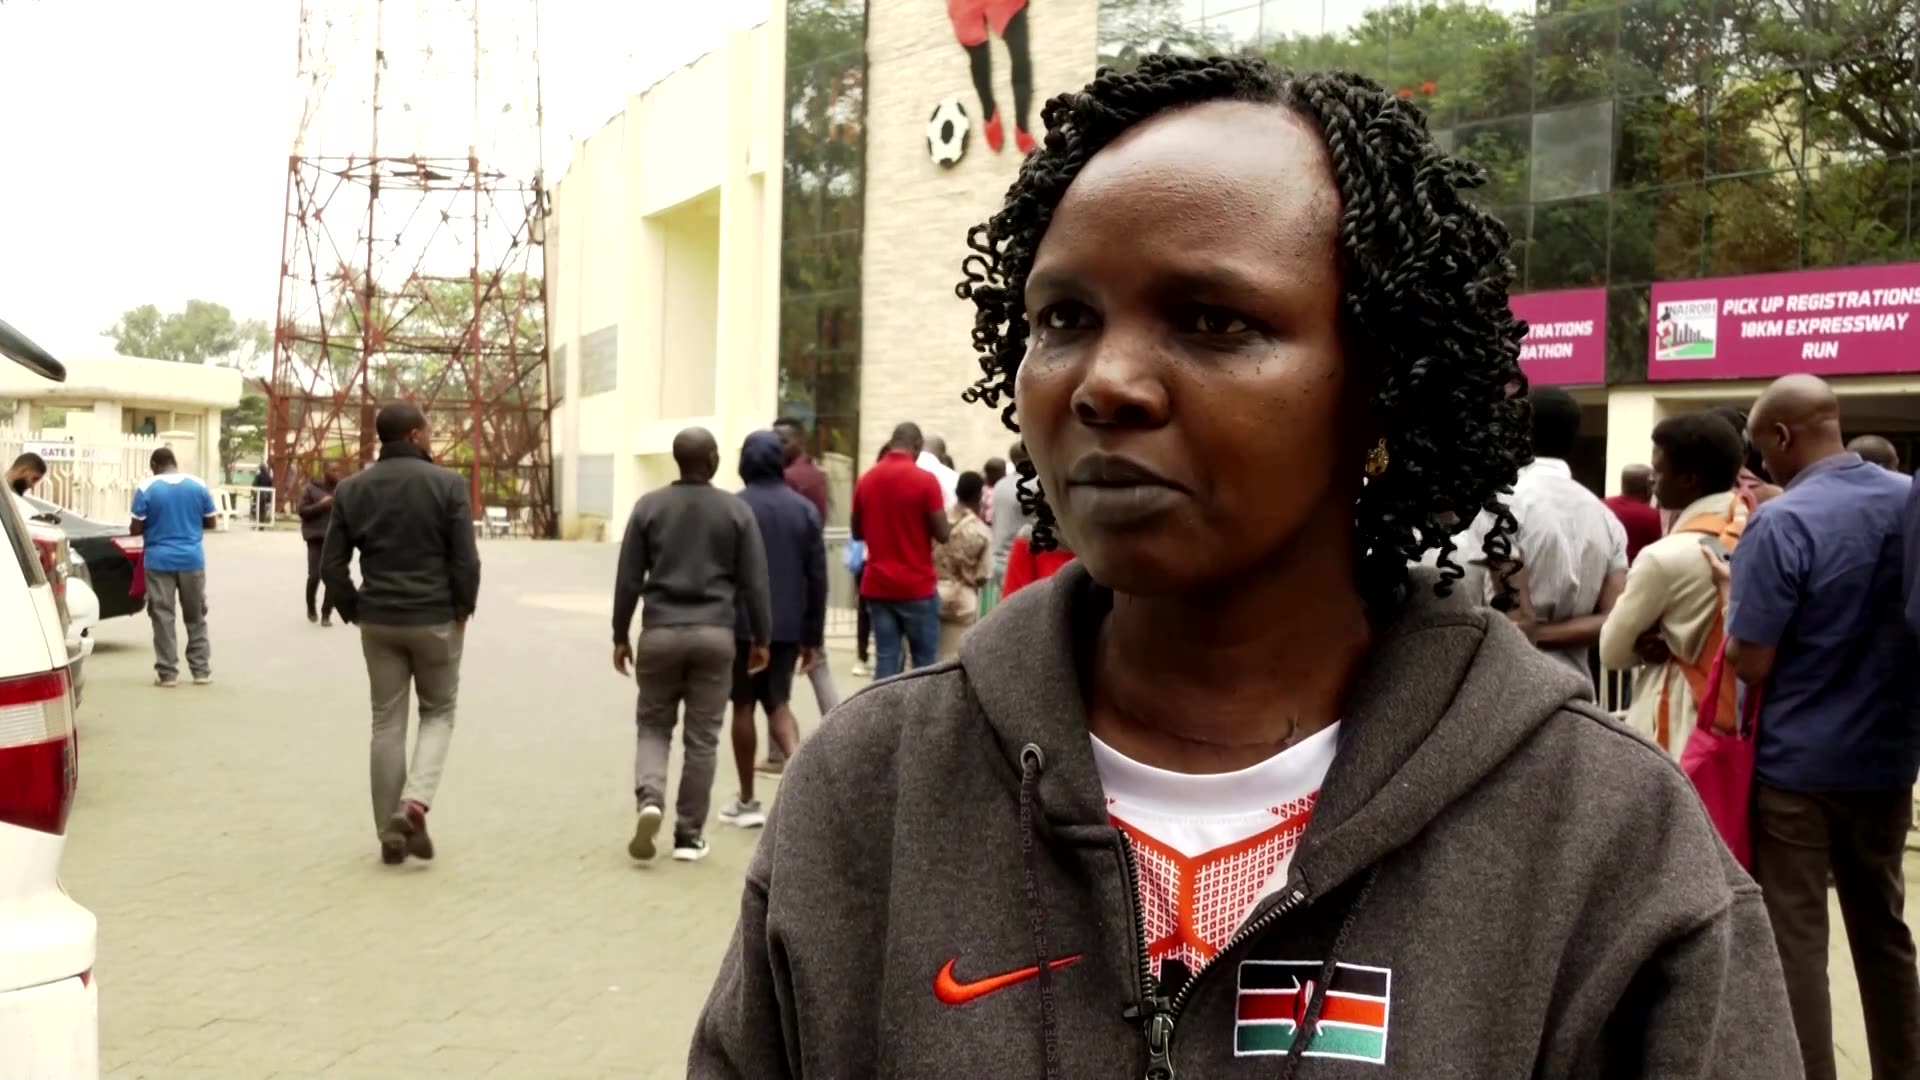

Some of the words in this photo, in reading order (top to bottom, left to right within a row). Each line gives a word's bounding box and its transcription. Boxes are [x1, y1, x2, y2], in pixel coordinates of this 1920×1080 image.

[1668, 303, 1716, 315] NAIROBI
[1723, 298, 1759, 316] PICK
[1761, 296, 1784, 313] UP
[1741, 319, 1784, 338] 10KM
[1785, 312, 1910, 336] EXPRESSWAY
[1802, 341, 1839, 360] RUN
[41, 448, 67, 457] GATE
